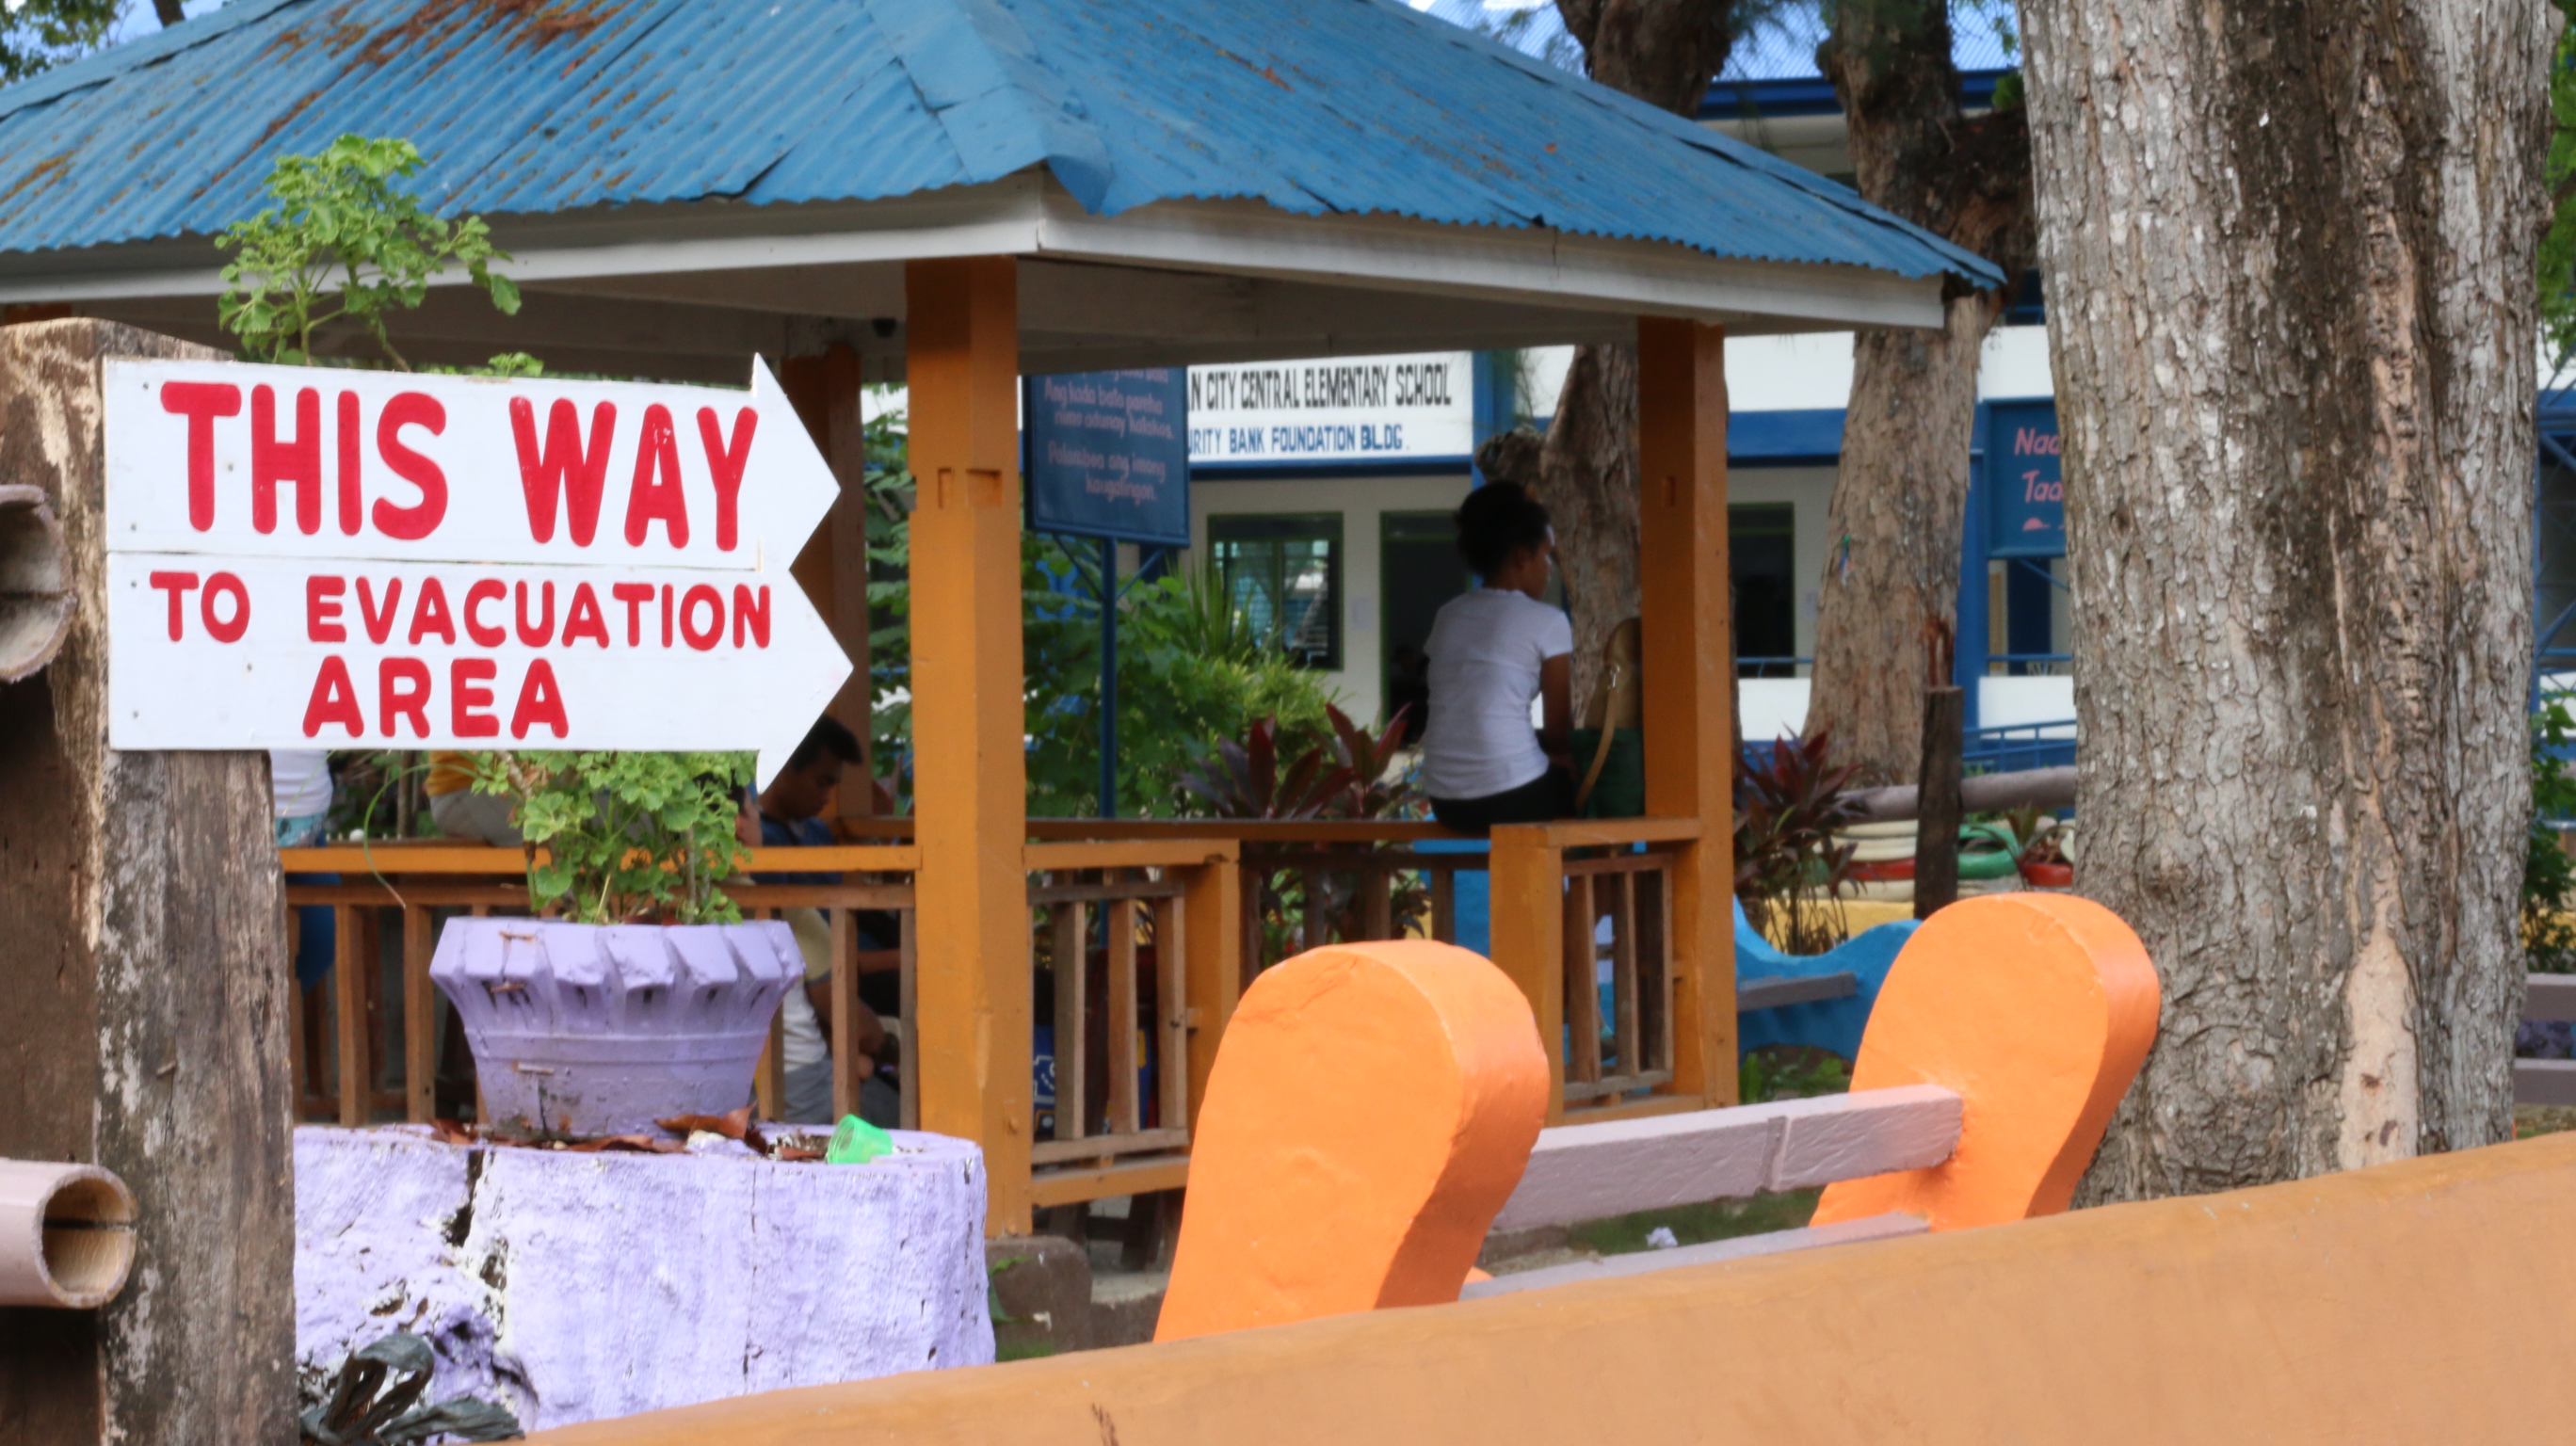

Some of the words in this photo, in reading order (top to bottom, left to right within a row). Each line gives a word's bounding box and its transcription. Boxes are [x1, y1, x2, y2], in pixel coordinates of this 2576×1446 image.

[1206, 371, 1237, 410] CITY
[1241, 368, 1300, 410] CENTRAL
[1304, 365, 1390, 408] ELEMENTARY
[1395, 362, 1452, 406] SCHOOL
[160, 381, 449, 541] THIS
[509, 396, 759, 553] WAY
[1229, 426, 1265, 454] BANK
[1271, 424, 1356, 453] FOUNDATION
[150, 570, 251, 644] TO
[306, 575, 771, 651] EVACUATION
[302, 654, 570, 740] AREA
